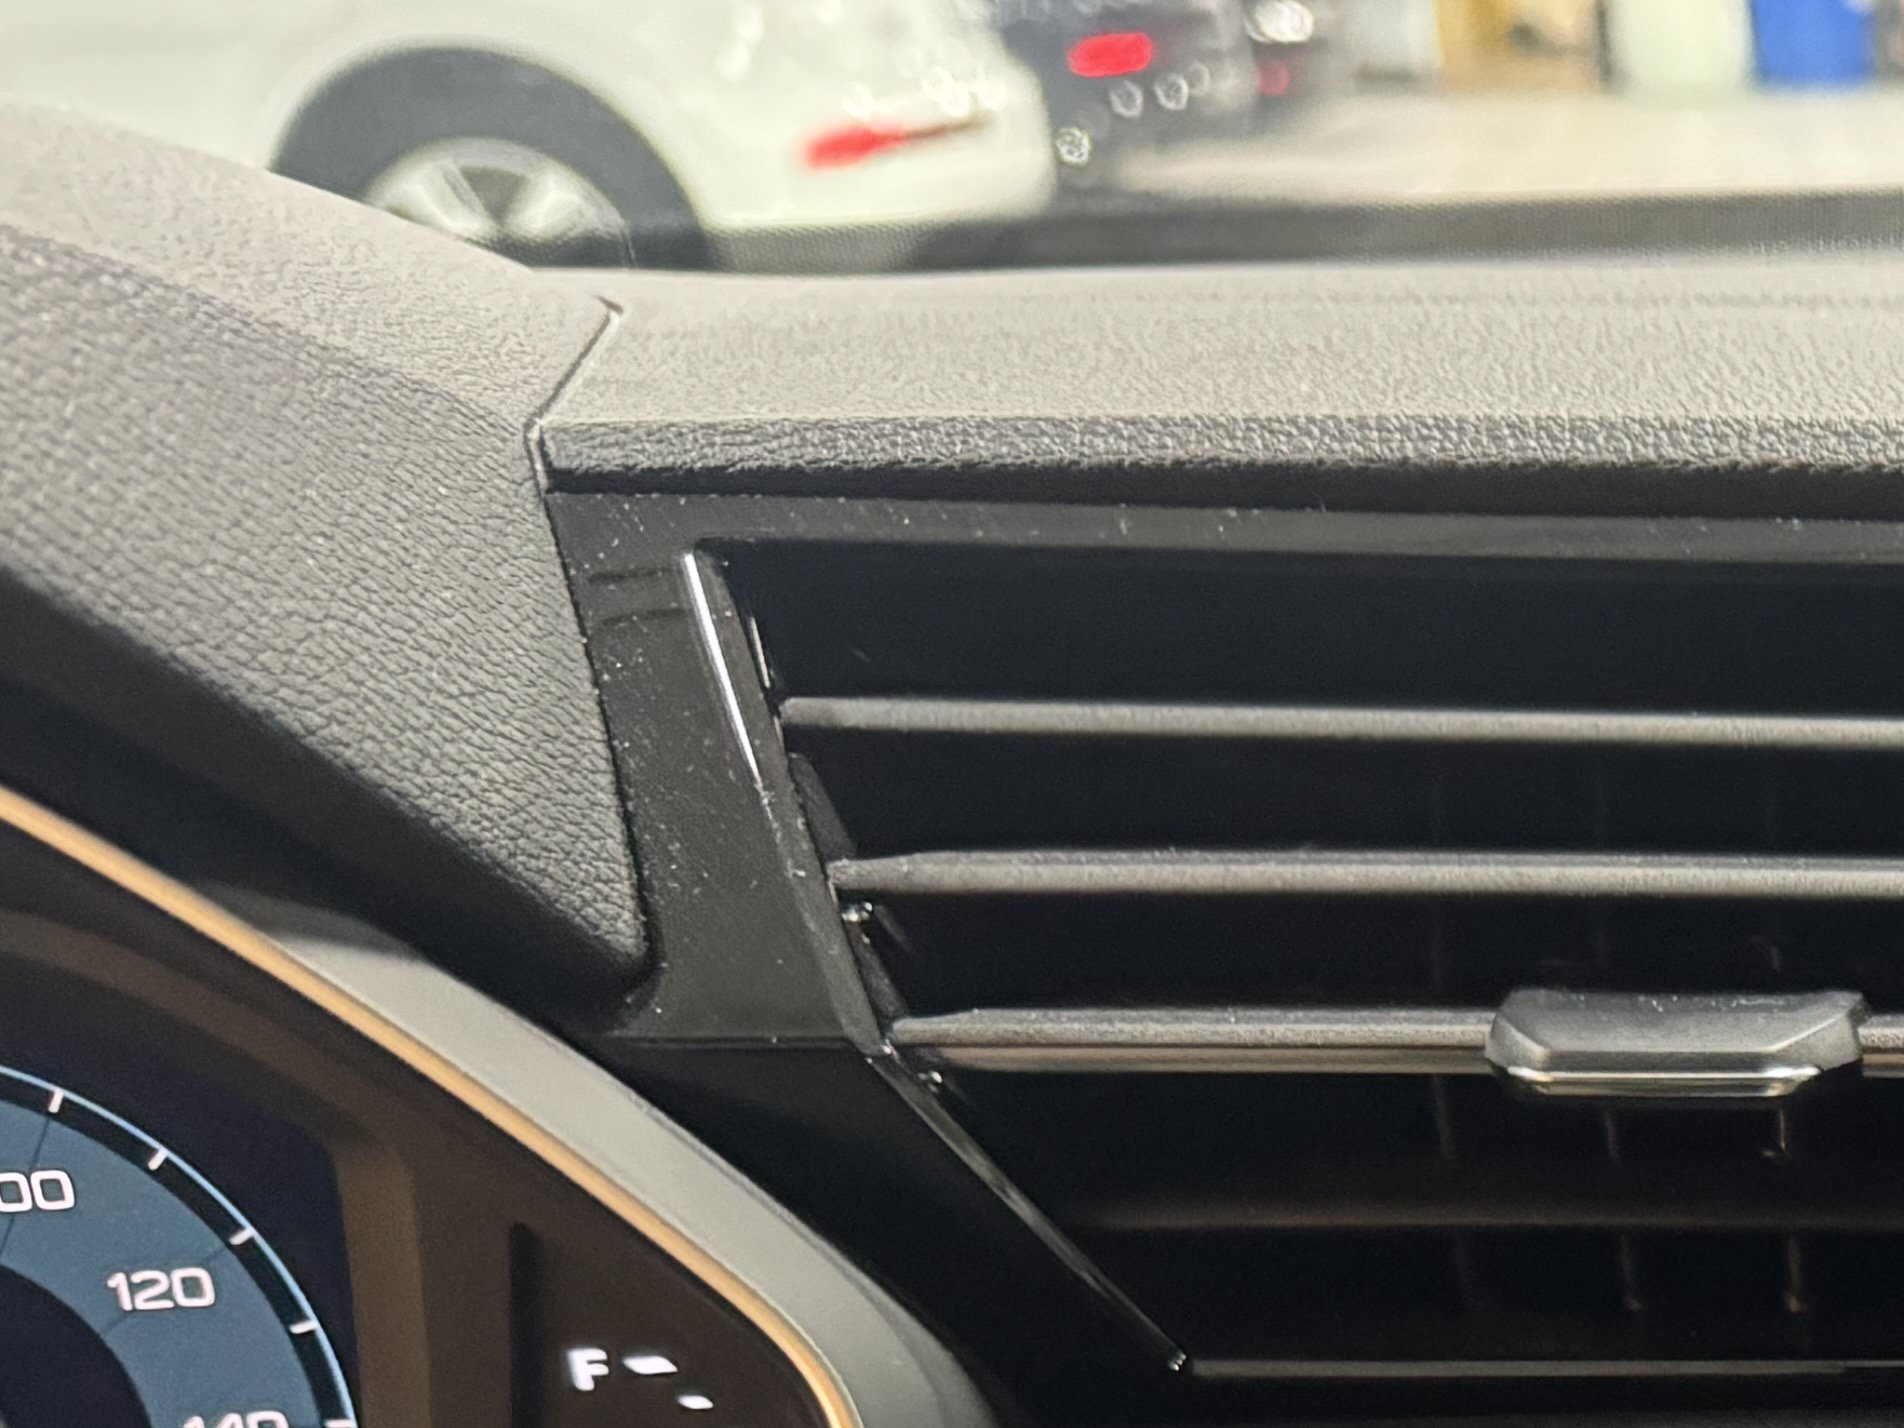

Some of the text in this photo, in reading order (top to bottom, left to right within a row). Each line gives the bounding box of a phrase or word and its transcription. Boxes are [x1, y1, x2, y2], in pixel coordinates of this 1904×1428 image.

[0, 1169, 75, 1212] 00
[106, 1266, 215, 1311] 120
[568, 1348, 609, 1391] F
